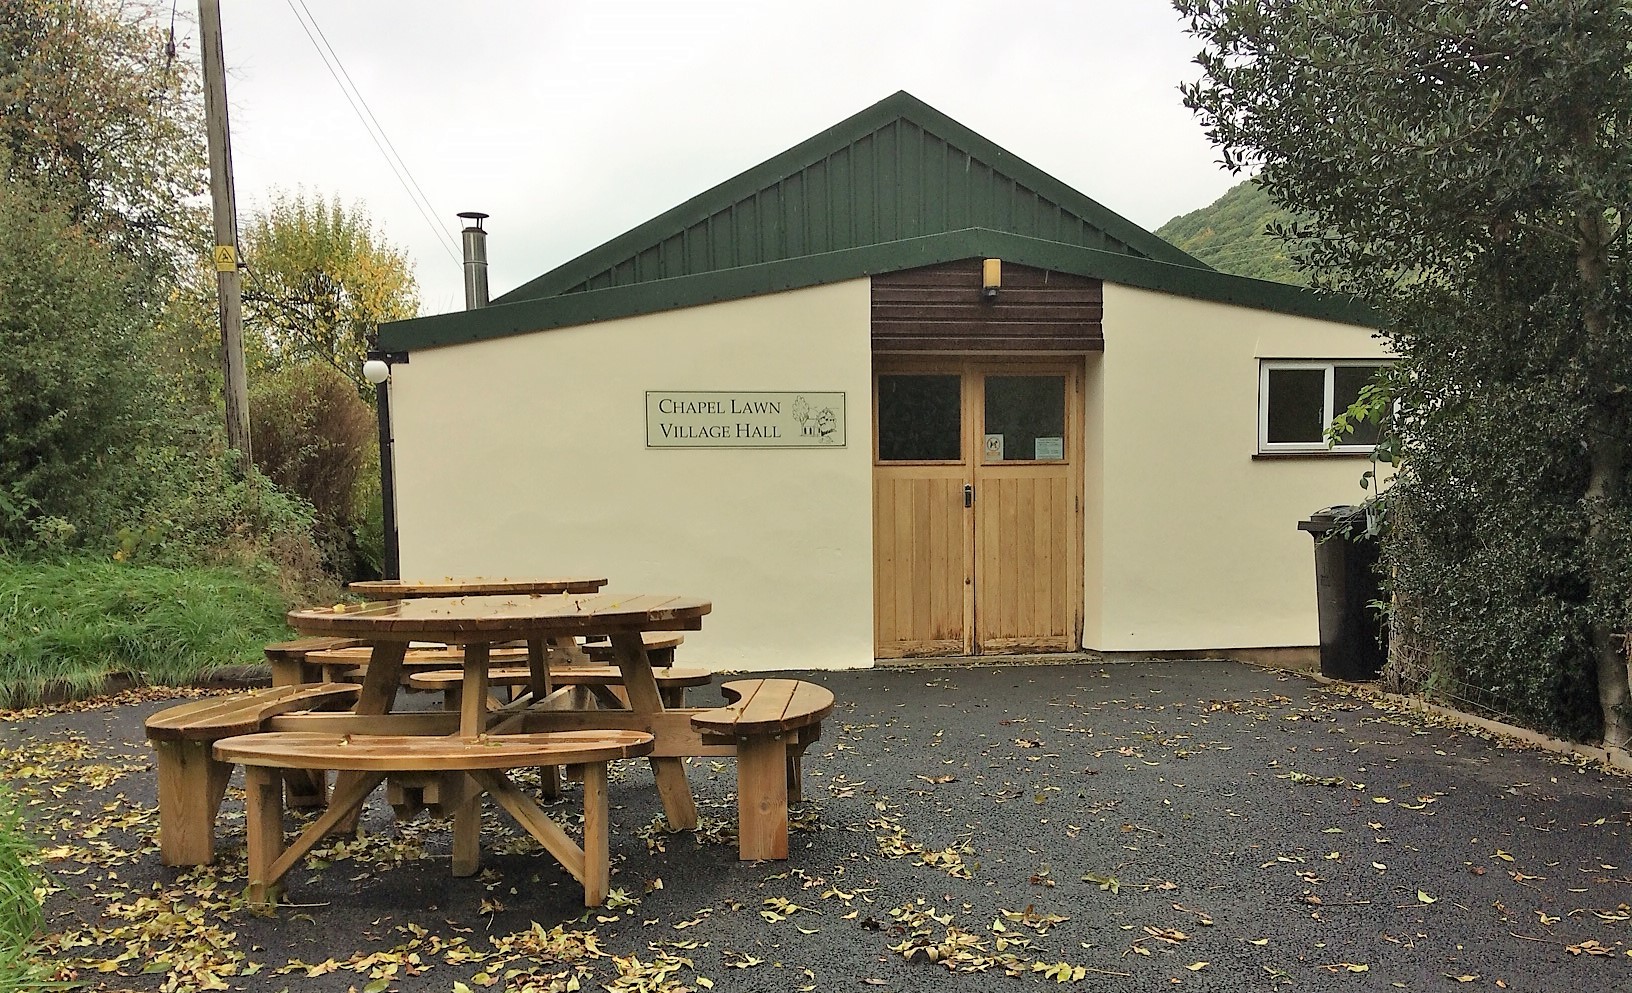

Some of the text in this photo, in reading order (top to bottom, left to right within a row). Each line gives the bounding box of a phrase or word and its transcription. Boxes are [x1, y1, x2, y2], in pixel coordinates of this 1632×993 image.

[658, 399, 781, 414] CHAPEL LAWN
[660, 423, 782, 438] VILLAGE HALL
